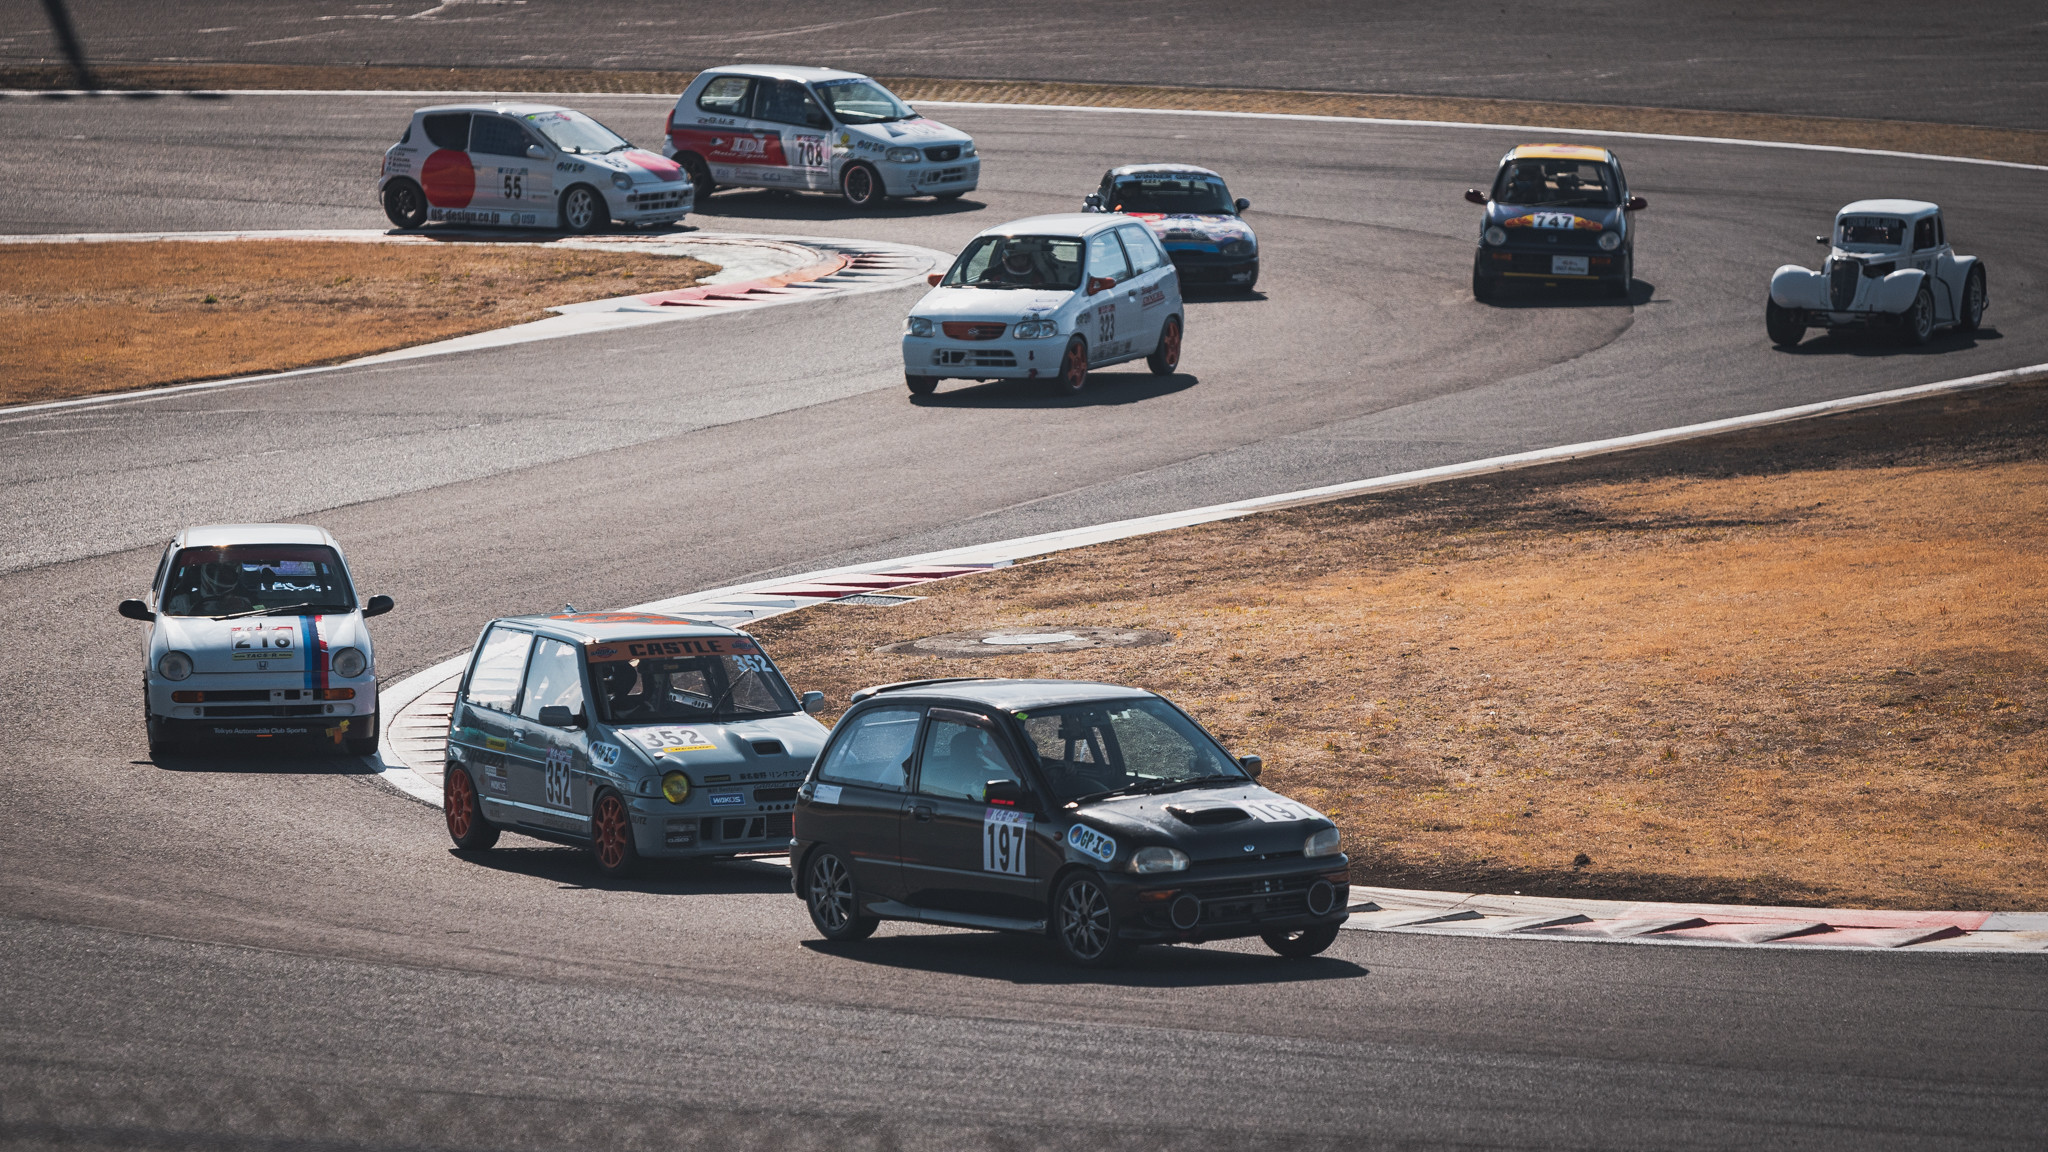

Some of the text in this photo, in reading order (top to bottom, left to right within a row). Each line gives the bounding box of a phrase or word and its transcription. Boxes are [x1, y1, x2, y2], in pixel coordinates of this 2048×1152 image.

[798, 142, 823, 166] 708
[504, 175, 521, 199] 55
[1536, 215, 1572, 229] 747
[1100, 313, 1115, 342] 323
[234, 630, 291, 649] 218
[628, 640, 725, 657] CASTLE
[732, 654, 773, 673] 352
[213, 727, 233, 735] Tokyo
[286, 727, 308, 735] Sports
[646, 730, 706, 748] 352
[547, 760, 571, 807] 352
[990, 809, 1020, 821] K4-GP
[1248, 803, 1313, 820] 197
[987, 822, 1024, 873] 197
